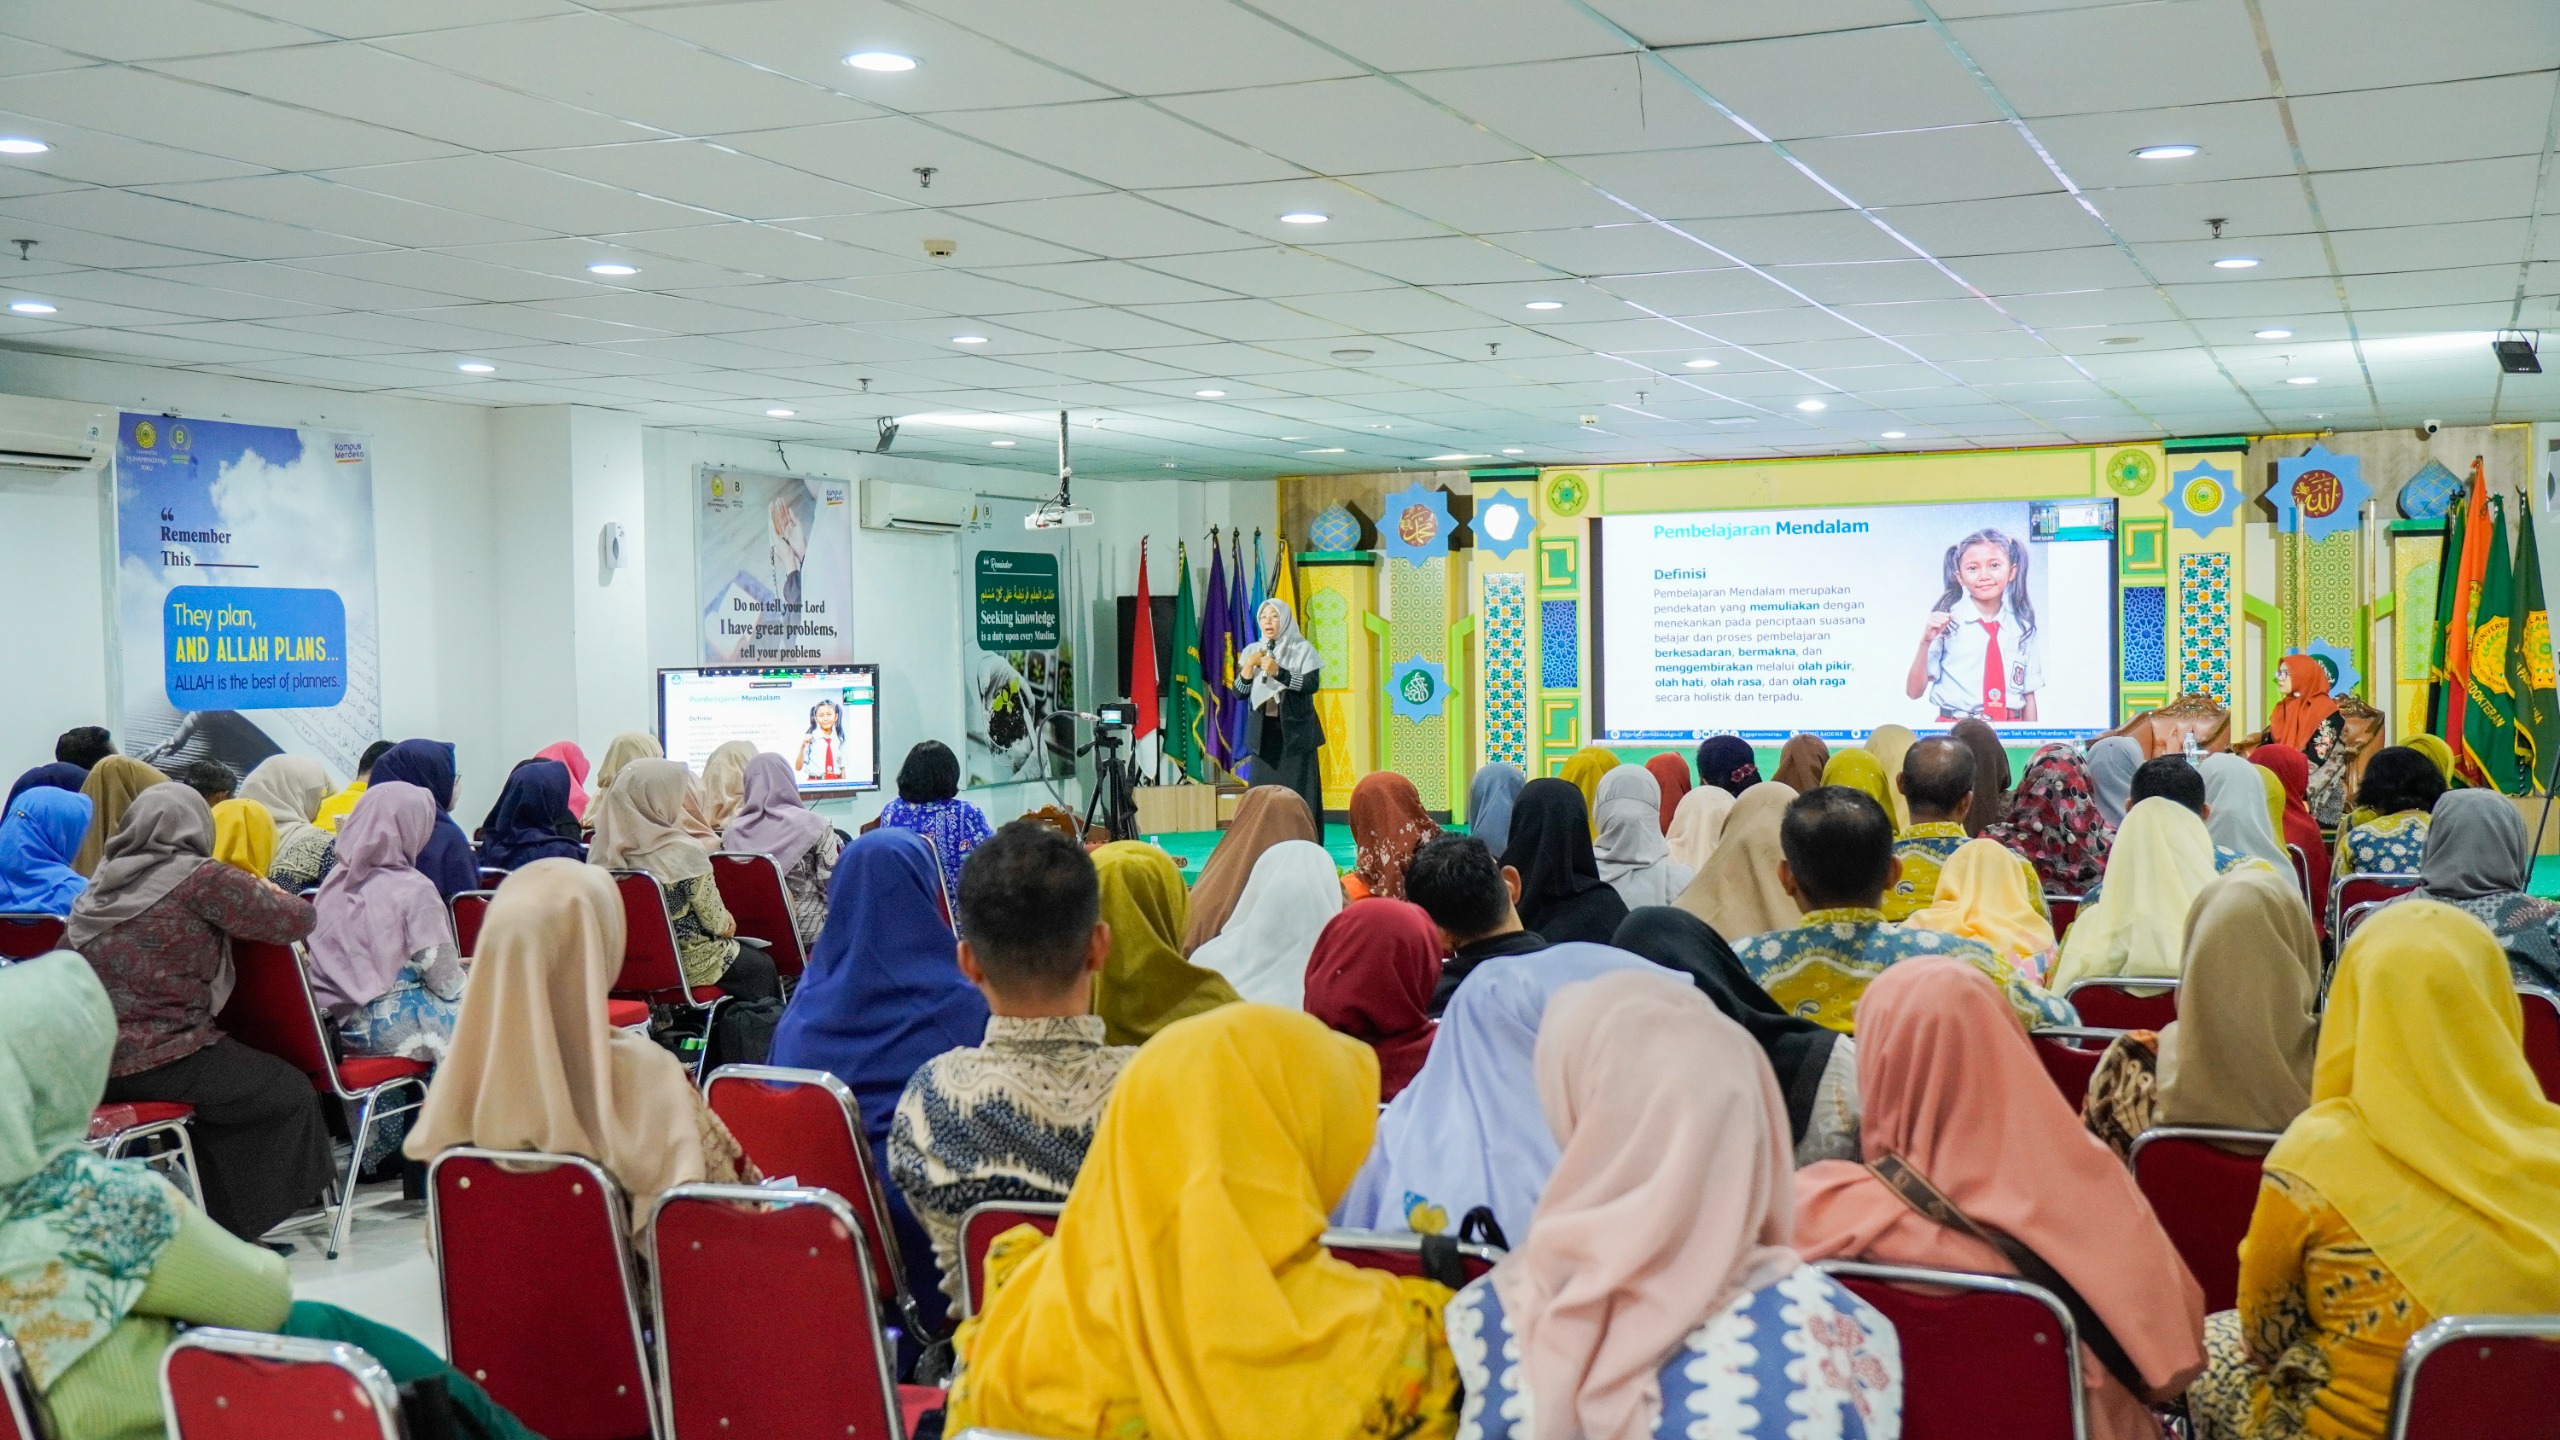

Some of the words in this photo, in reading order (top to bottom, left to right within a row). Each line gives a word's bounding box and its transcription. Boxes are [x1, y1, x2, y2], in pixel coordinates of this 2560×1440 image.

[160, 525, 232, 544] Remember
[1654, 523, 1771, 540] Pembelajaran
[1776, 519, 1869, 535] Mendalam
[160, 550, 191, 567] This
[1654, 567, 1706, 580] Definisi
[1654, 588, 1726, 599] Pembelajaran
[1729, 586, 1785, 597] Mendalam
[1789, 585, 1851, 597] merupakan
[733, 597, 747, 612] Do
[749, 601, 765, 612] not
[766, 598, 781, 613] tell
[782, 602, 803, 616] your
[805, 600, 825, 614] Lord
[1654, 603, 1716, 615] pendekatan
[1719, 604, 1746, 615] yang
[1750, 601, 1820, 611] memuliakan
[1822, 600, 1865, 612] dengan
[172, 602, 213, 632] They
[218, 602, 257, 632] plan,
[980, 609, 1014, 628] Seeking
[1015, 610, 1056, 628] knowledge
[1654, 617, 1722, 628] menekankan
[1724, 617, 1751, 629] pada
[1755, 616, 1816, 629] penciptaan
[1819, 616, 1866, 626] suasana
[720, 619, 725, 635] I
[727, 618, 753, 635] have
[755, 622, 784, 640] great
[786, 619, 838, 640] problems,
[981, 631, 987, 641] is
[992, 630, 1004, 643] duty
[1005, 633, 1019, 643] upon
[1020, 633, 1034, 643] every
[1034, 630, 1057, 641] Muslim.
[2477, 621, 2508, 644] UNIVERSI
[1654, 632, 1690, 645] belajar
[1693, 632, 1713, 643] dan
[1716, 634, 1752, 644] proses
[1756, 631, 1831, 644] pembelajaran
[175, 636, 209, 663] AND
[216, 636, 269, 662] ALLAH
[275, 636, 339, 662] PLANS...
[740, 644, 756, 658] tell
[757, 649, 778, 662] your
[780, 644, 822, 662] problems
[1655, 647, 1735, 658] berkesadaran,
[1738, 647, 1799, 658] bermakna,
[1802, 646, 1823, 656] dan
[1655, 662, 1753, 674] menggembirakan
[1756, 661, 1795, 671] melalui
[1797, 661, 1822, 671] olah
[1825, 660, 1855, 673] pikir,
[175, 674, 214, 691] ALLAH
[217, 674, 227, 690] is
[230, 673, 248, 690] the
[251, 673, 276, 690] best
[279, 672, 290, 693] of
[292, 671, 340, 693] planners.
[1655, 677, 1679, 687] olah
[1681, 677, 1707, 688] hati,
[1711, 676, 1735, 687] olah
[1737, 678, 1765, 688] rasa,
[1768, 676, 1789, 686] dan
[1792, 676, 1817, 686] olah
[1820, 678, 1846, 688] raga
[741, 694, 780, 702] Mendalam
[1655, 693, 1690, 703] secara
[1694, 692, 1731, 702] holistik
[1734, 692, 1754, 702] dan
[1758, 692, 1803, 704] terpadu.
[2468, 679, 2506, 728] EDOKTERAN
